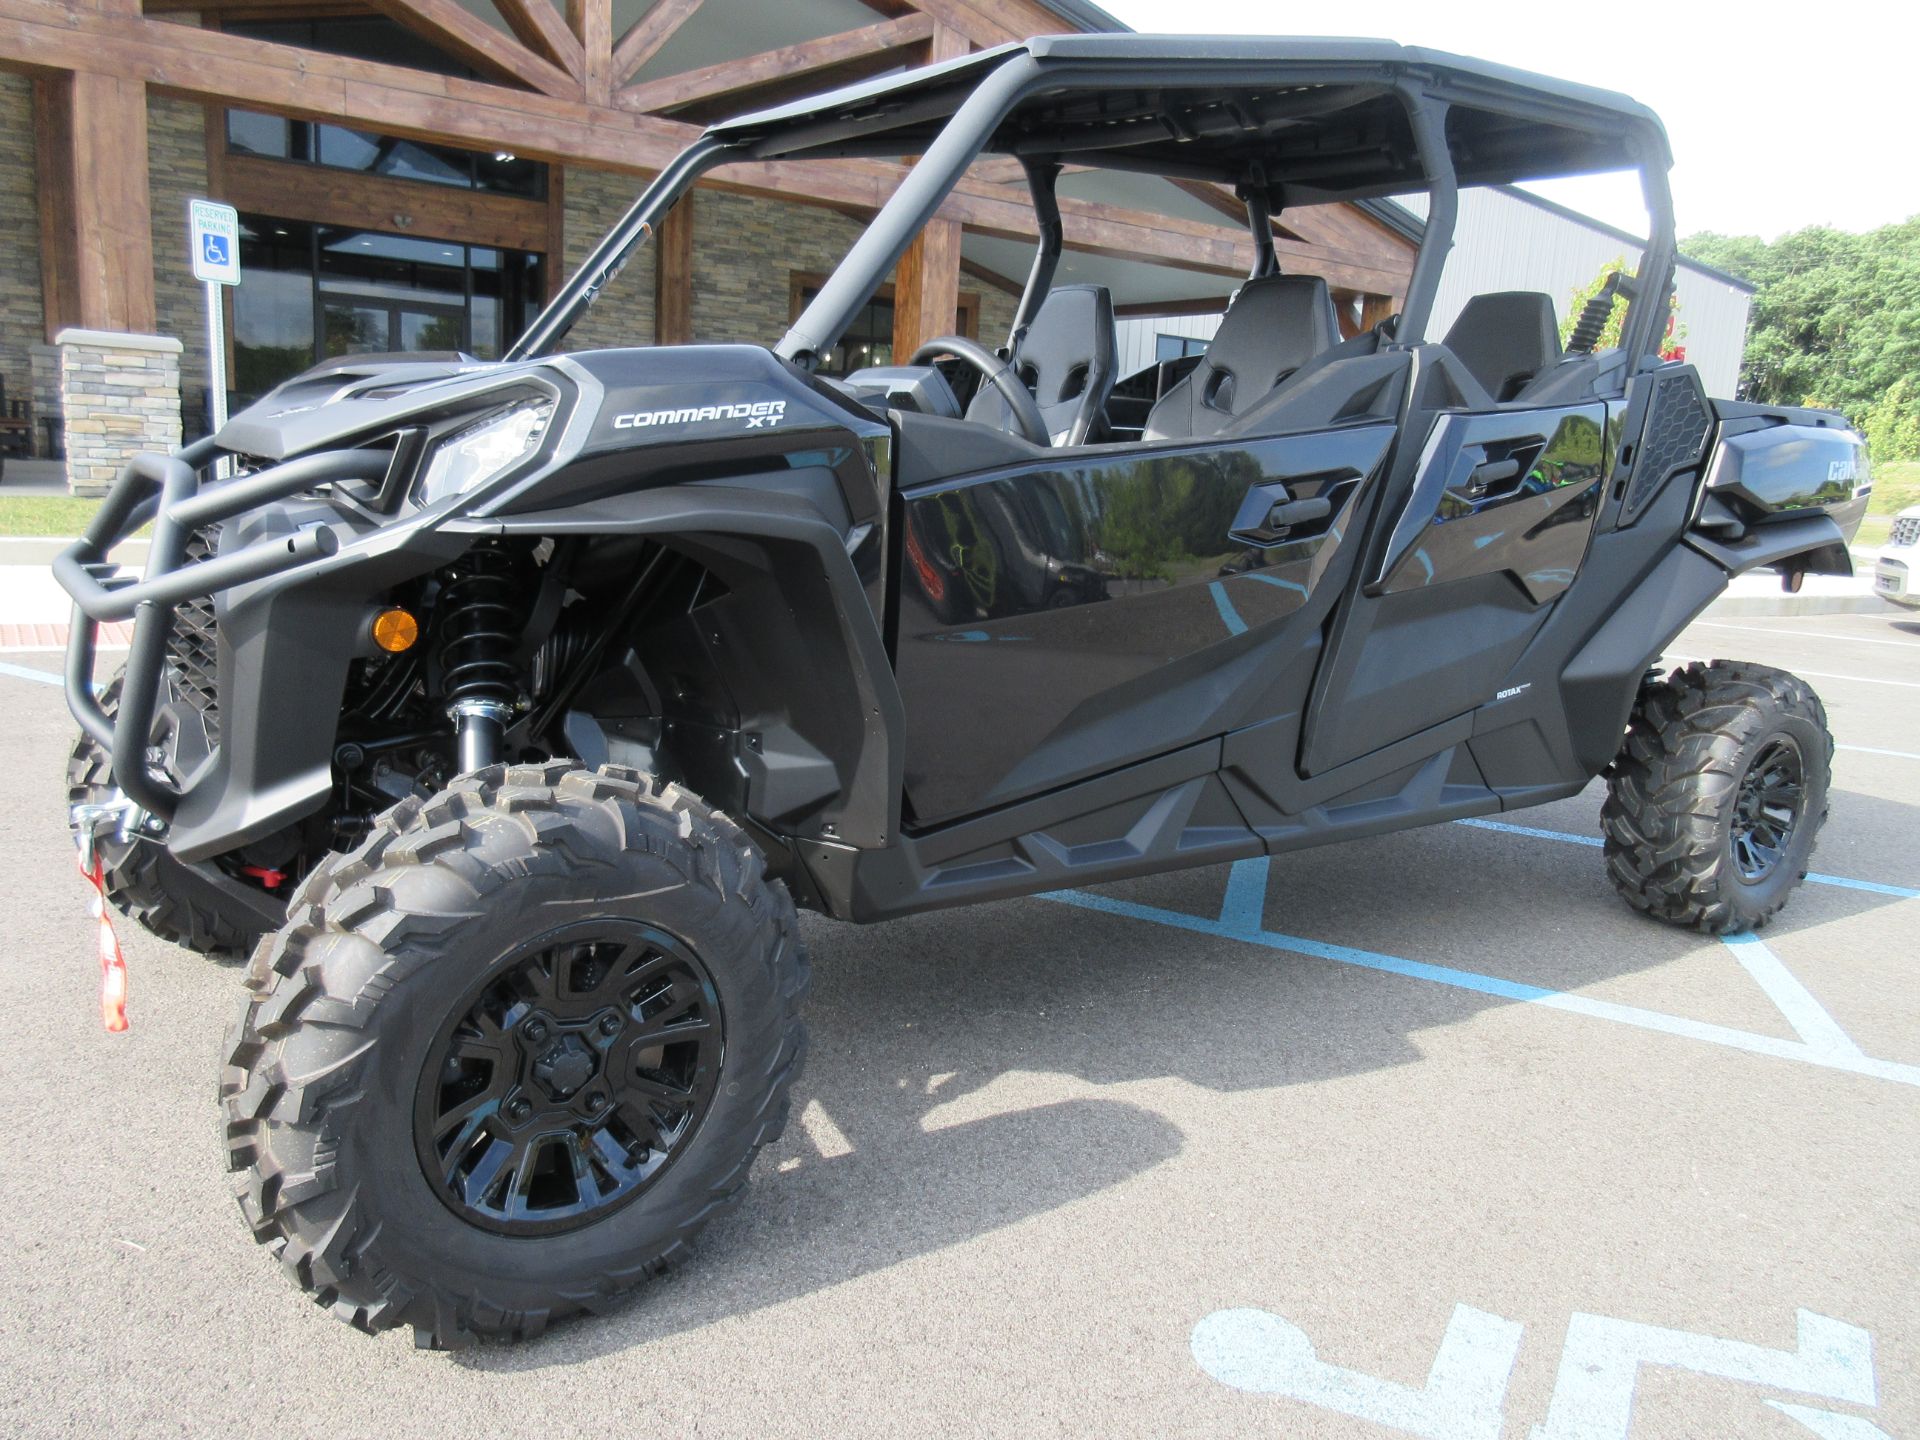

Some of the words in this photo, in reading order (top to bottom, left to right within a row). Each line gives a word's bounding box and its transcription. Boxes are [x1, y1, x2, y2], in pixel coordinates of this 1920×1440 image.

[194, 206, 234, 223] RESERVED
[198, 219, 232, 235] PARKING
[614, 400, 787, 429] COMMANDER
[745, 415, 784, 429] XT
[1496, 686, 1521, 700] ROTAX
